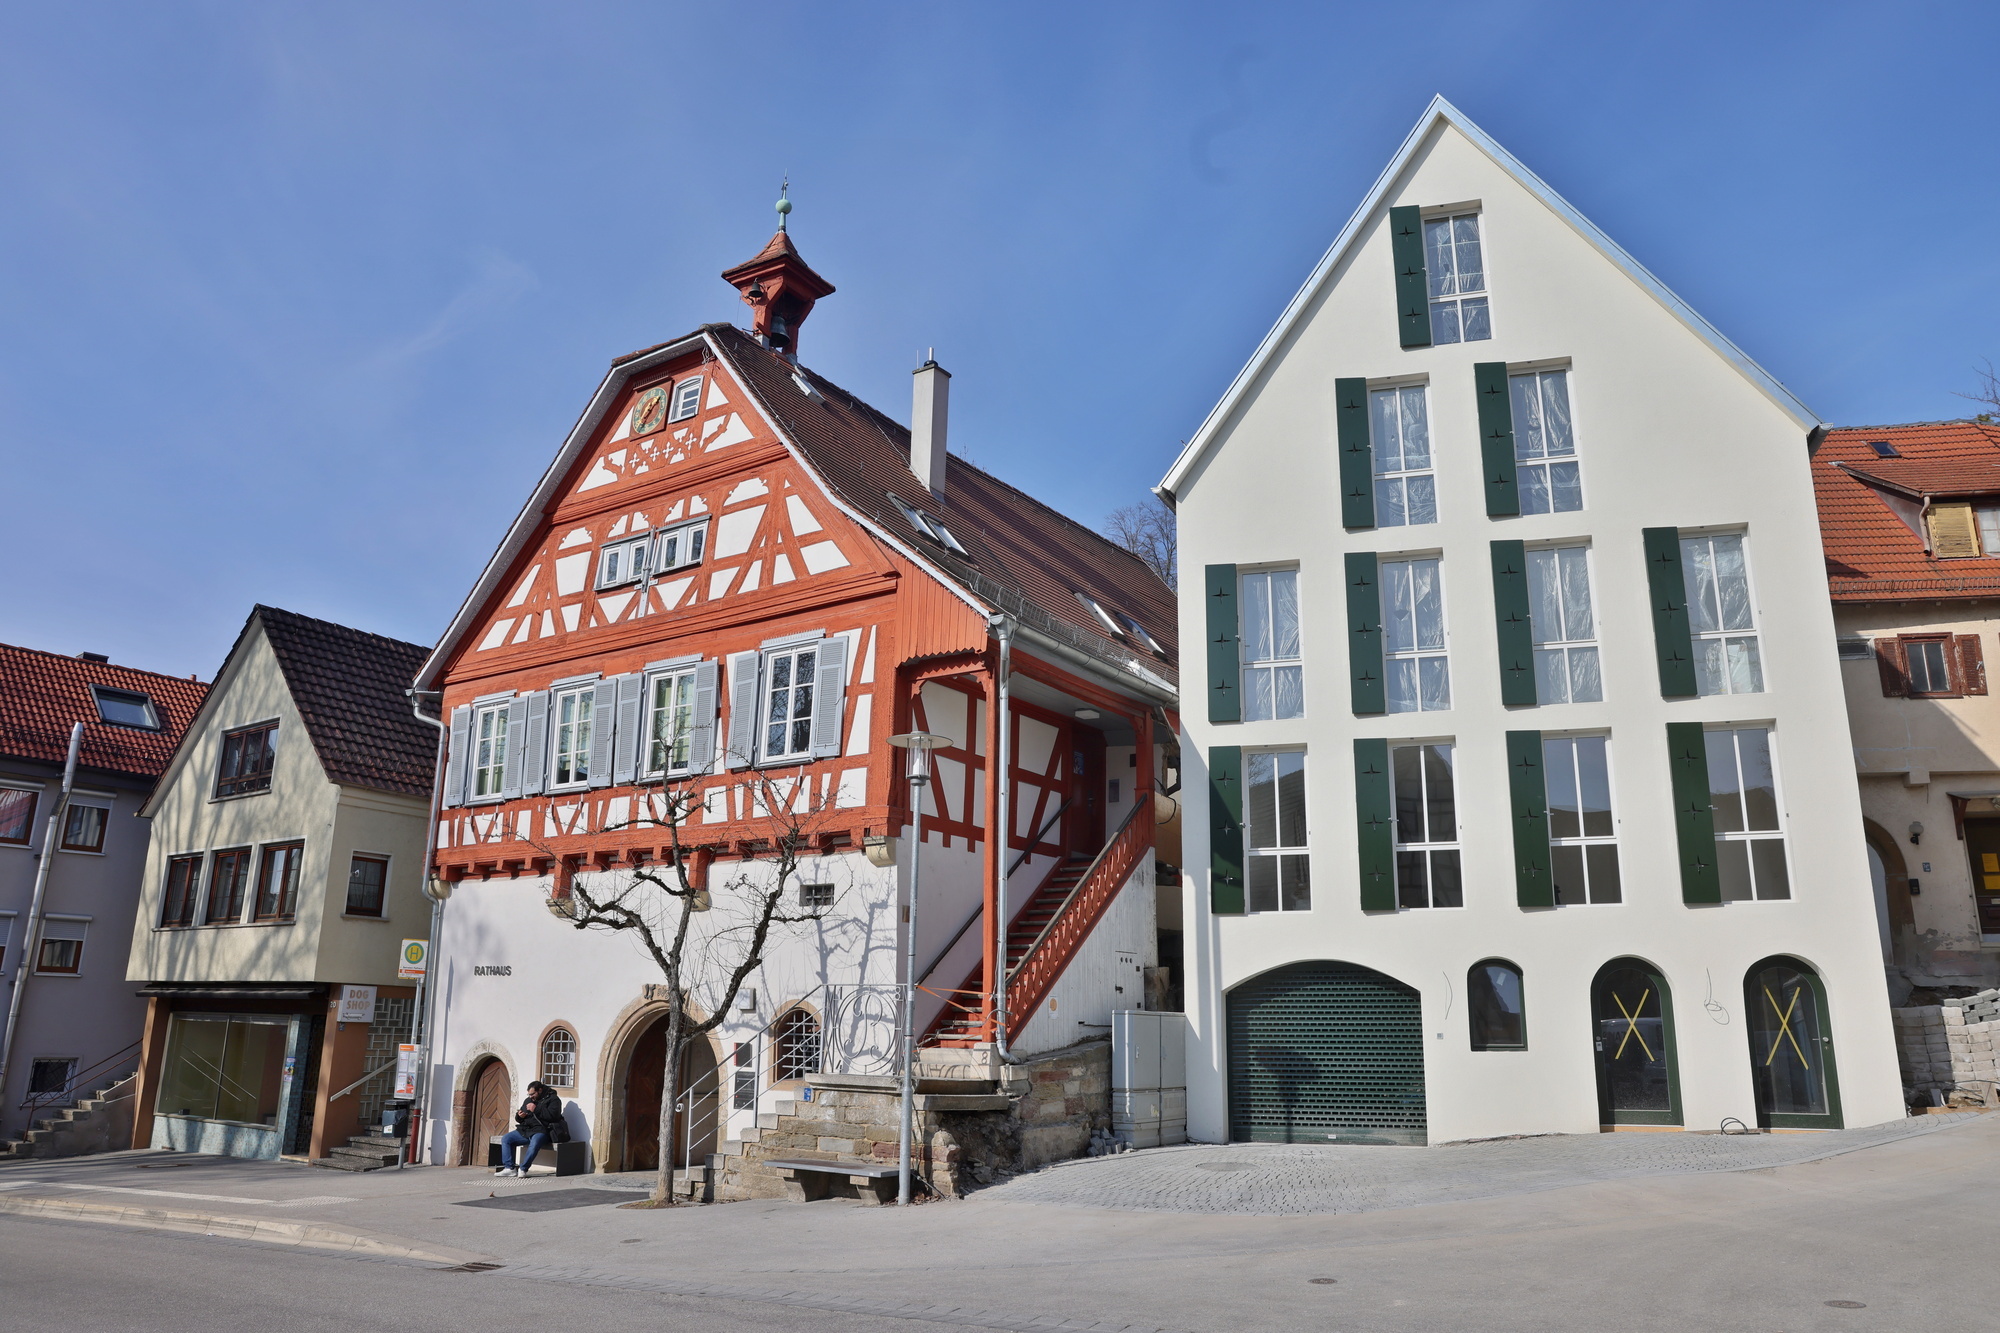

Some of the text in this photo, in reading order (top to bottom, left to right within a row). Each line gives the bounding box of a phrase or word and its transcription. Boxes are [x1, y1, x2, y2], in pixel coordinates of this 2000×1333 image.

[474, 965, 512, 976] RATHAUS
[350, 989, 370, 999] DOG
[346, 1000, 371, 1010] SHOP
